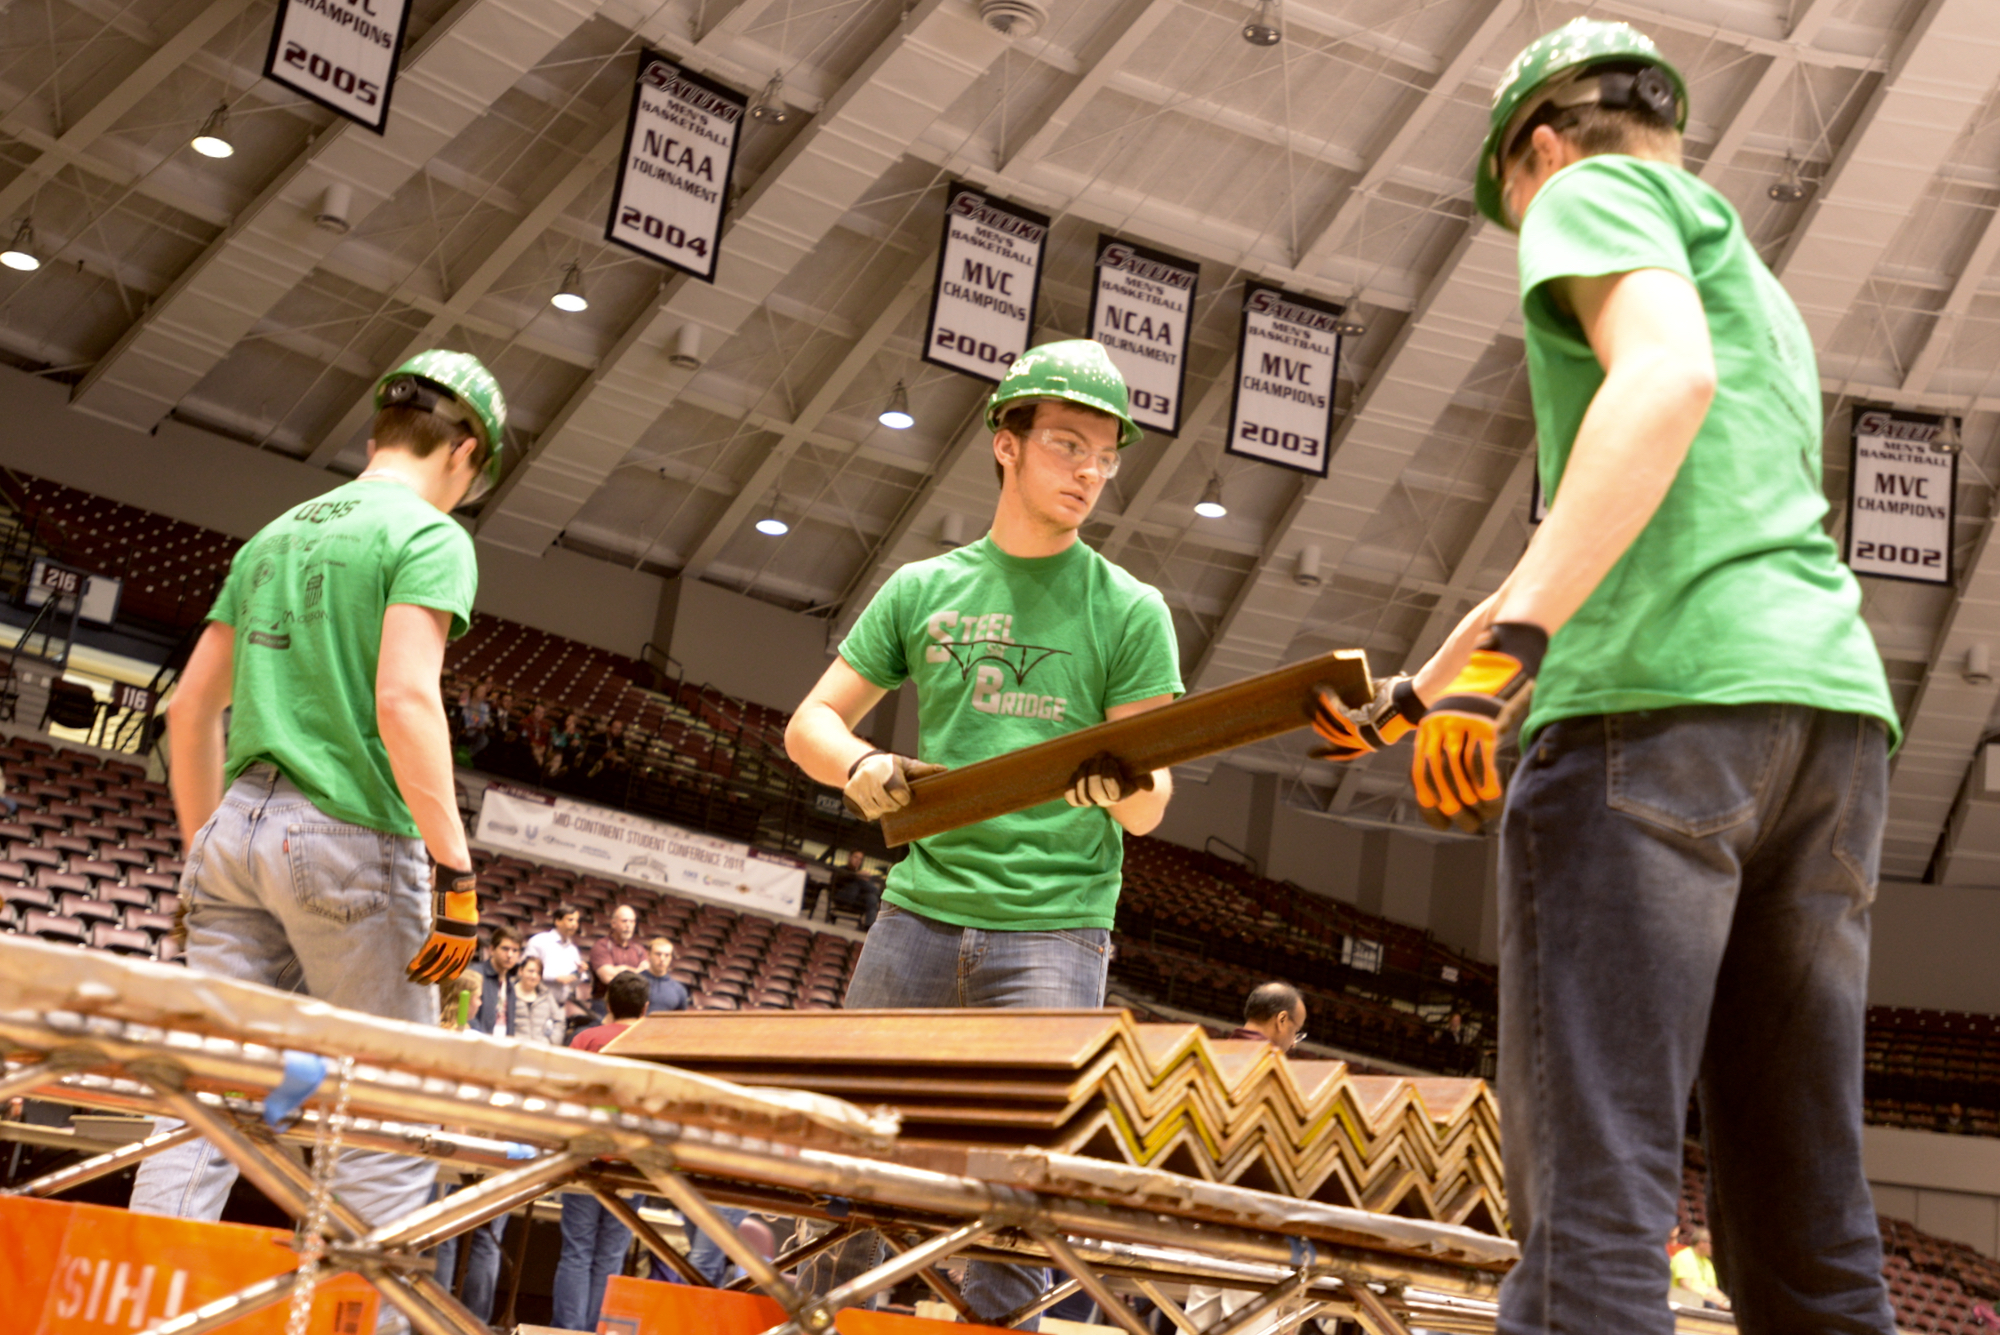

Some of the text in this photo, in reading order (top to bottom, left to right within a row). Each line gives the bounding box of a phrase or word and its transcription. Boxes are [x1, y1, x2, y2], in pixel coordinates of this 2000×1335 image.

[296, 0, 392, 49] HAMPIONS
[283, 40, 380, 106] 2005
[641, 61, 743, 123] SALUKI
[642, 100, 730, 148] BASKETBALL
[667, 99, 709, 125] MEN'S
[643, 128, 714, 183] NCAA
[632, 156, 719, 204] TOURNAMENT
[621, 205, 708, 258] 2004
[949, 191, 1046, 244] SALUKI
[951, 229, 1034, 267] BASKETBALL
[975, 226, 1015, 249] MEN'S
[962, 257, 1014, 296] MVC
[1098, 243, 1195, 291] SALUKI
[944, 281, 1027, 322] CHAMPIONS
[1102, 280, 1185, 314] BASKETBALL
[1125, 275, 1165, 296] MEN'S
[1105, 305, 1172, 346] NCAA
[1248, 325, 1332, 356] BASKETBALL
[1272, 321, 1312, 340] MEN'S
[936, 327, 1016, 368] 2004
[1098, 331, 1178, 366] TOURNAMENT
[1261, 352, 1312, 386] MVC
[1126, 386, 1170, 416] 03
[1243, 376, 1326, 409] CHAMPIONS
[1241, 421, 1319, 457] 2003
[1883, 441, 1926, 454] MEN'S
[1860, 448, 1949, 468] BASKETBALL
[1875, 472, 1929, 499] MVC
[1857, 496, 1946, 520] CHAMPIONS
[1856, 541, 1942, 568] 2002
[45, 569, 77, 591] 216
[926, 610, 1015, 664] STEEL
[121, 686, 149, 710] 116
[971, 664, 1067, 722] BRIDGE
[553, 811, 624, 841] MID-CONTINENT
[626, 830, 666, 852] STUDENT
[667, 840, 721, 867] CONFERENCE
